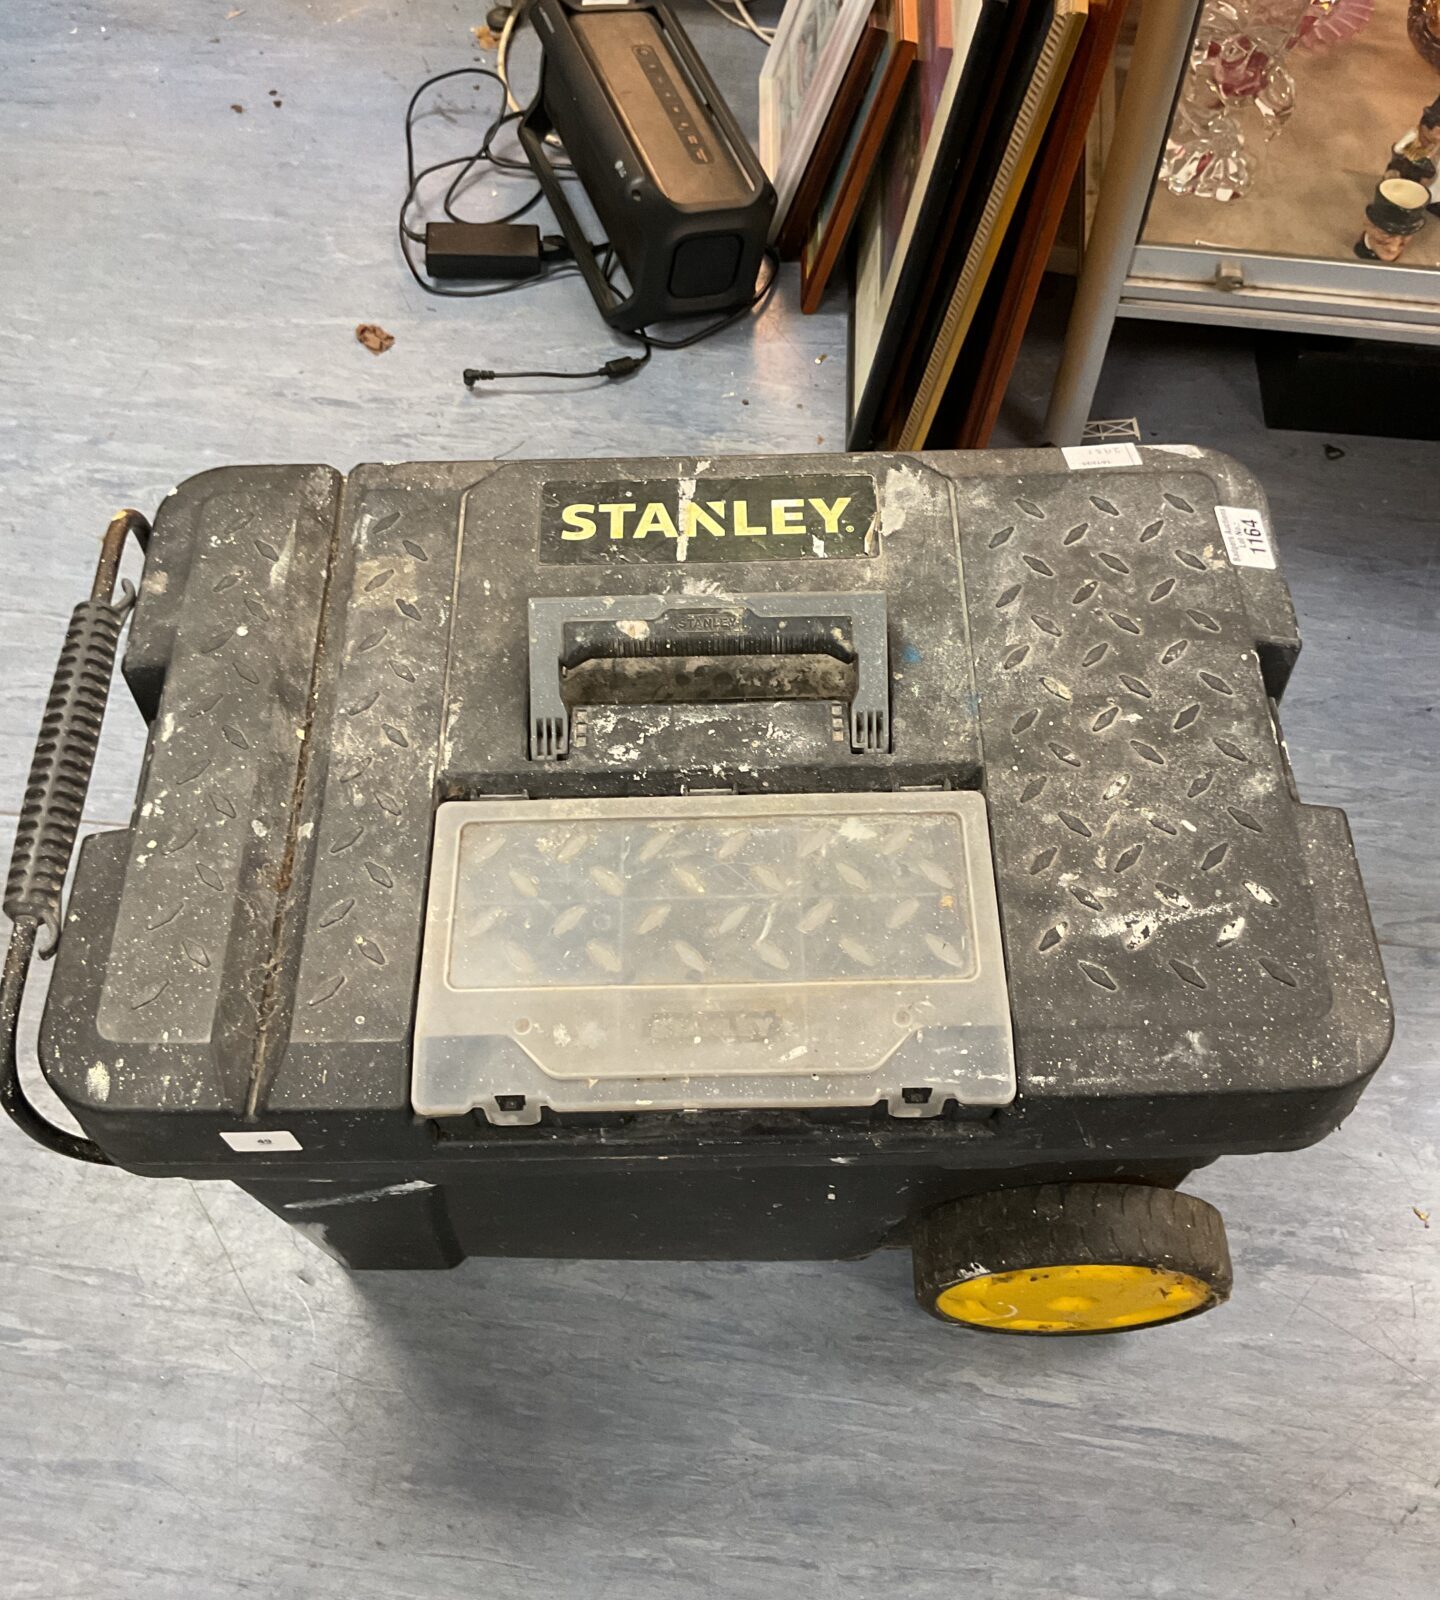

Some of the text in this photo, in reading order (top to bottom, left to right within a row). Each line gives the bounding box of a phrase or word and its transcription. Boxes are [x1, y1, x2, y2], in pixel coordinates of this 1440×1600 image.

[560, 497, 853, 541] STANLEY
[1240, 519, 1267, 554] 1164
[678, 616, 738, 629] STANLEY
